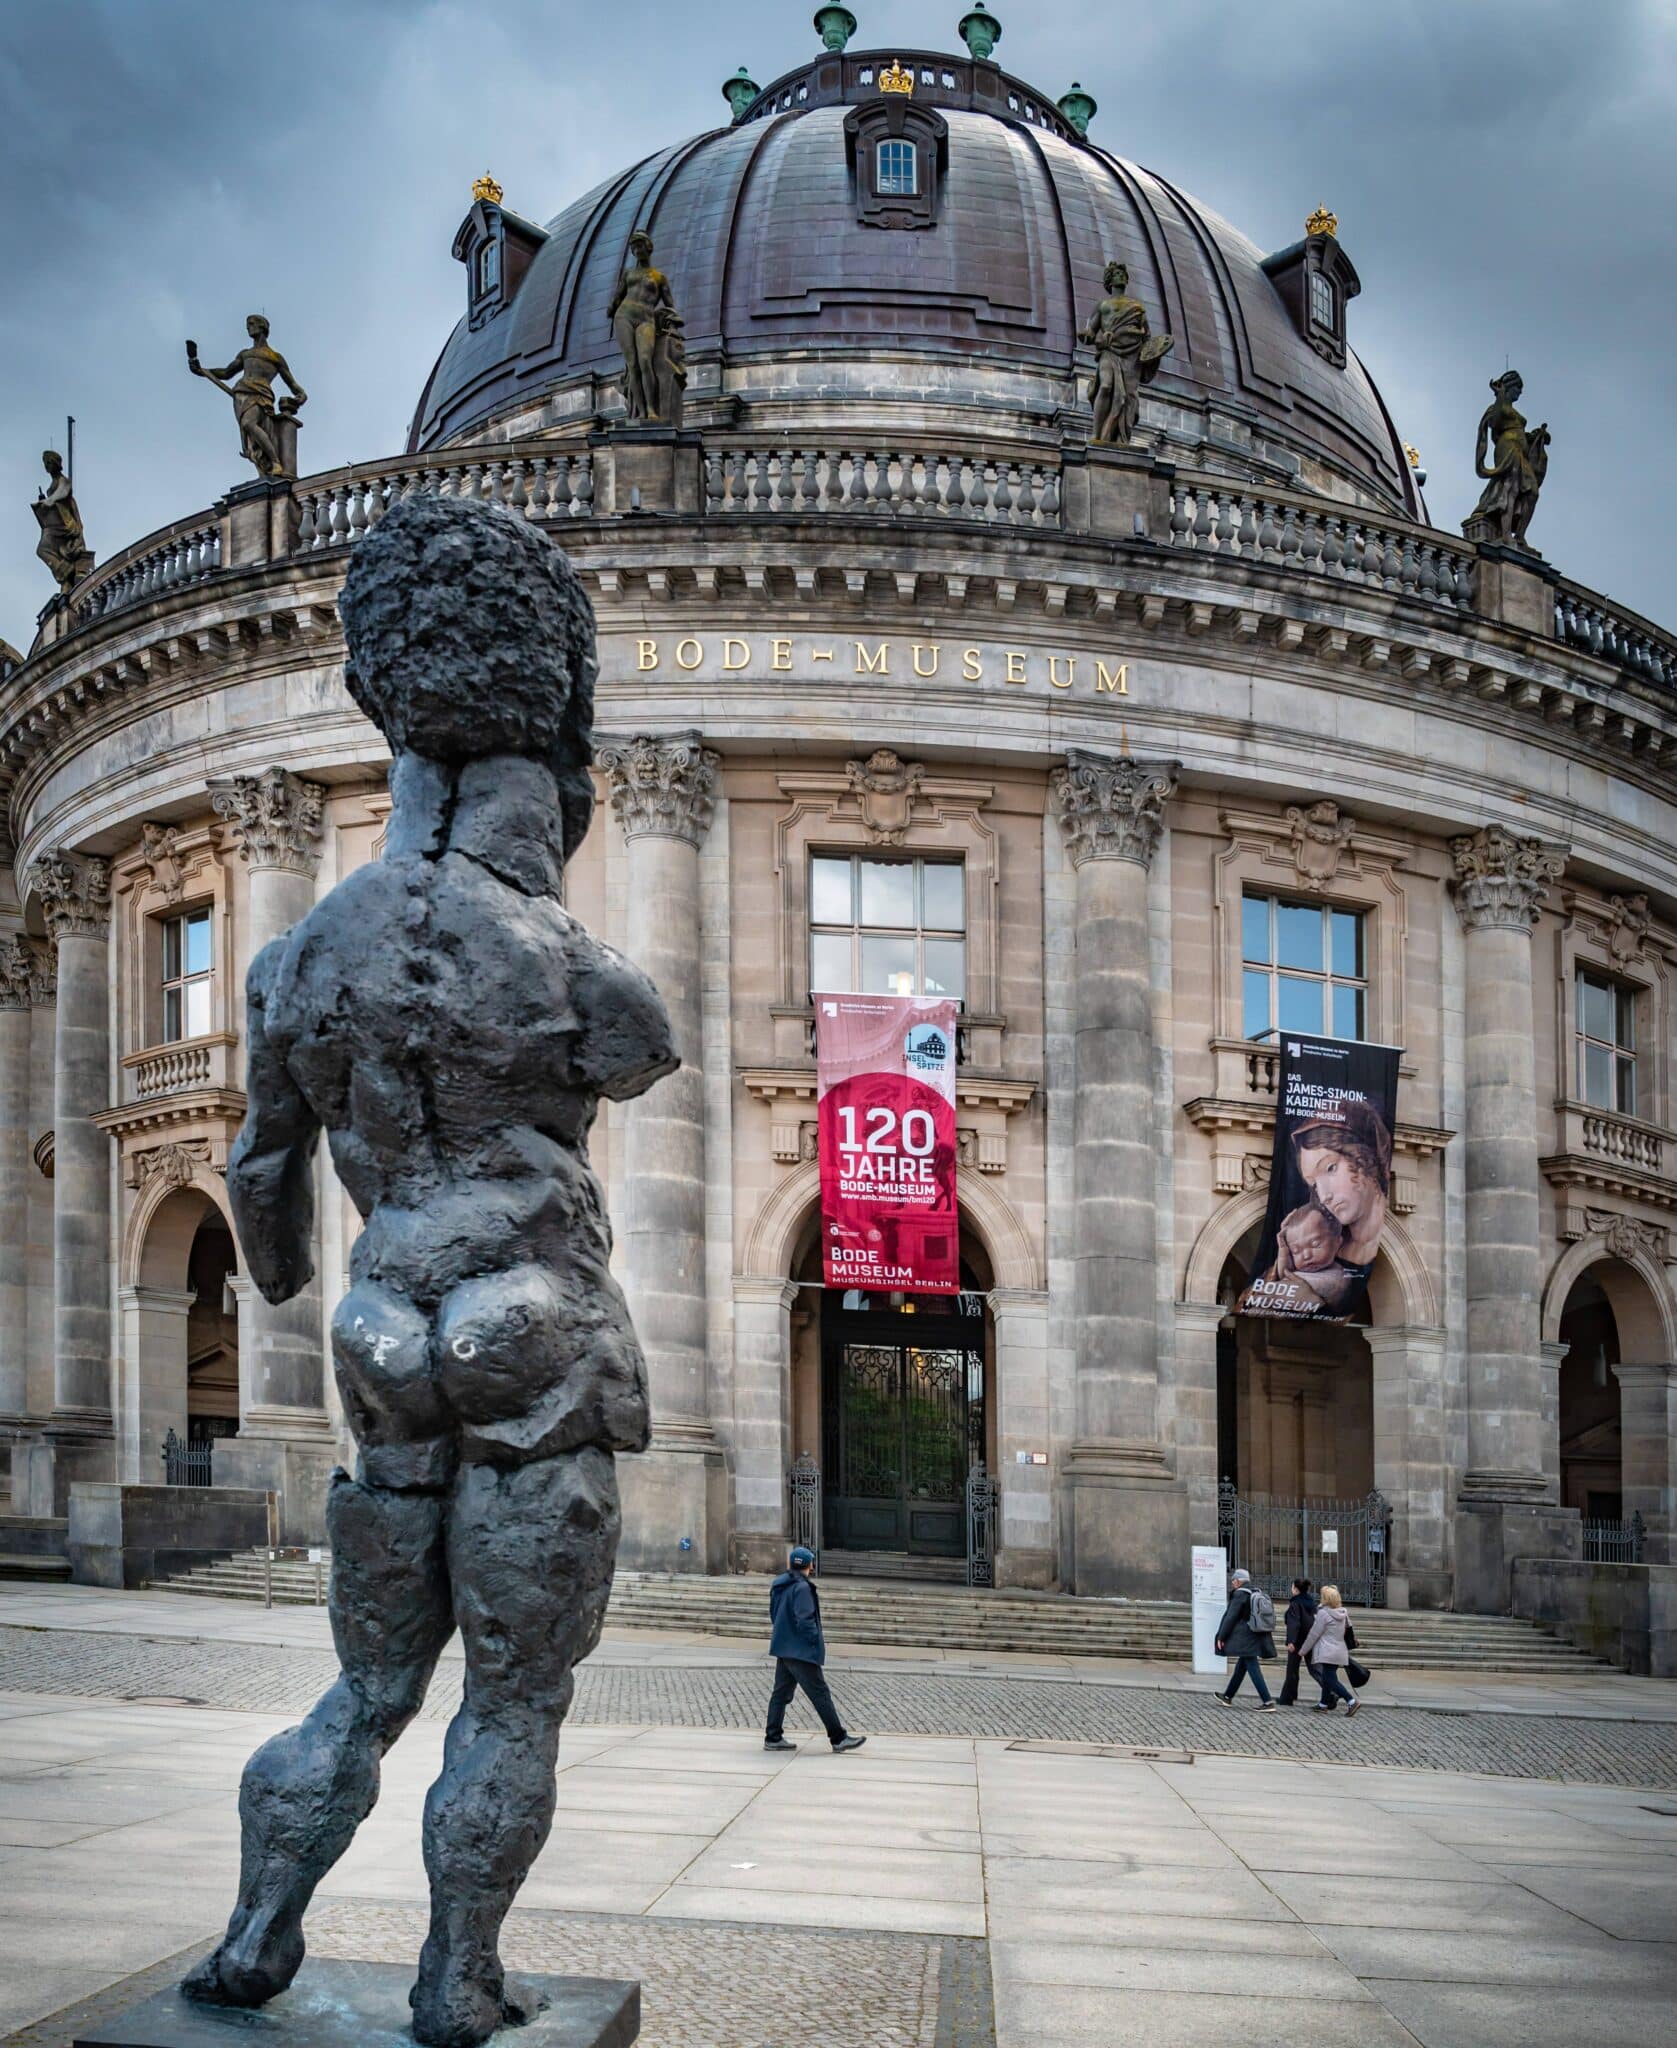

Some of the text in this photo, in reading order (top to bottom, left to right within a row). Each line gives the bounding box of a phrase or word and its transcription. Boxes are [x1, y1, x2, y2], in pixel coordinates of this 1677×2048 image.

[636, 639, 1128, 694] BODE-MUSEUM
[917, 1062, 945, 1071] SPITZE
[1287, 1073, 1302, 1082] DAS
[1286, 1082, 1368, 1102] JAMES-SIMON-
[1285, 1095, 1341, 1112] KABINETT
[1285, 1107, 1346, 1122] IM BODE-MUSEUM
[838, 1106, 935, 1157] 120
[840, 1155, 935, 1183] JAHRE
[840, 1179, 936, 1196] BODE-MUSEUM
[831, 1246, 879, 1263] BODE
[832, 1263, 913, 1278] MUSEUM
[832, 1277, 952, 1288] MUSEUMSINSEL BERLIN
[1252, 1278, 1299, 1298] BODE
[1246, 1295, 1320, 1313] MUSEUM
